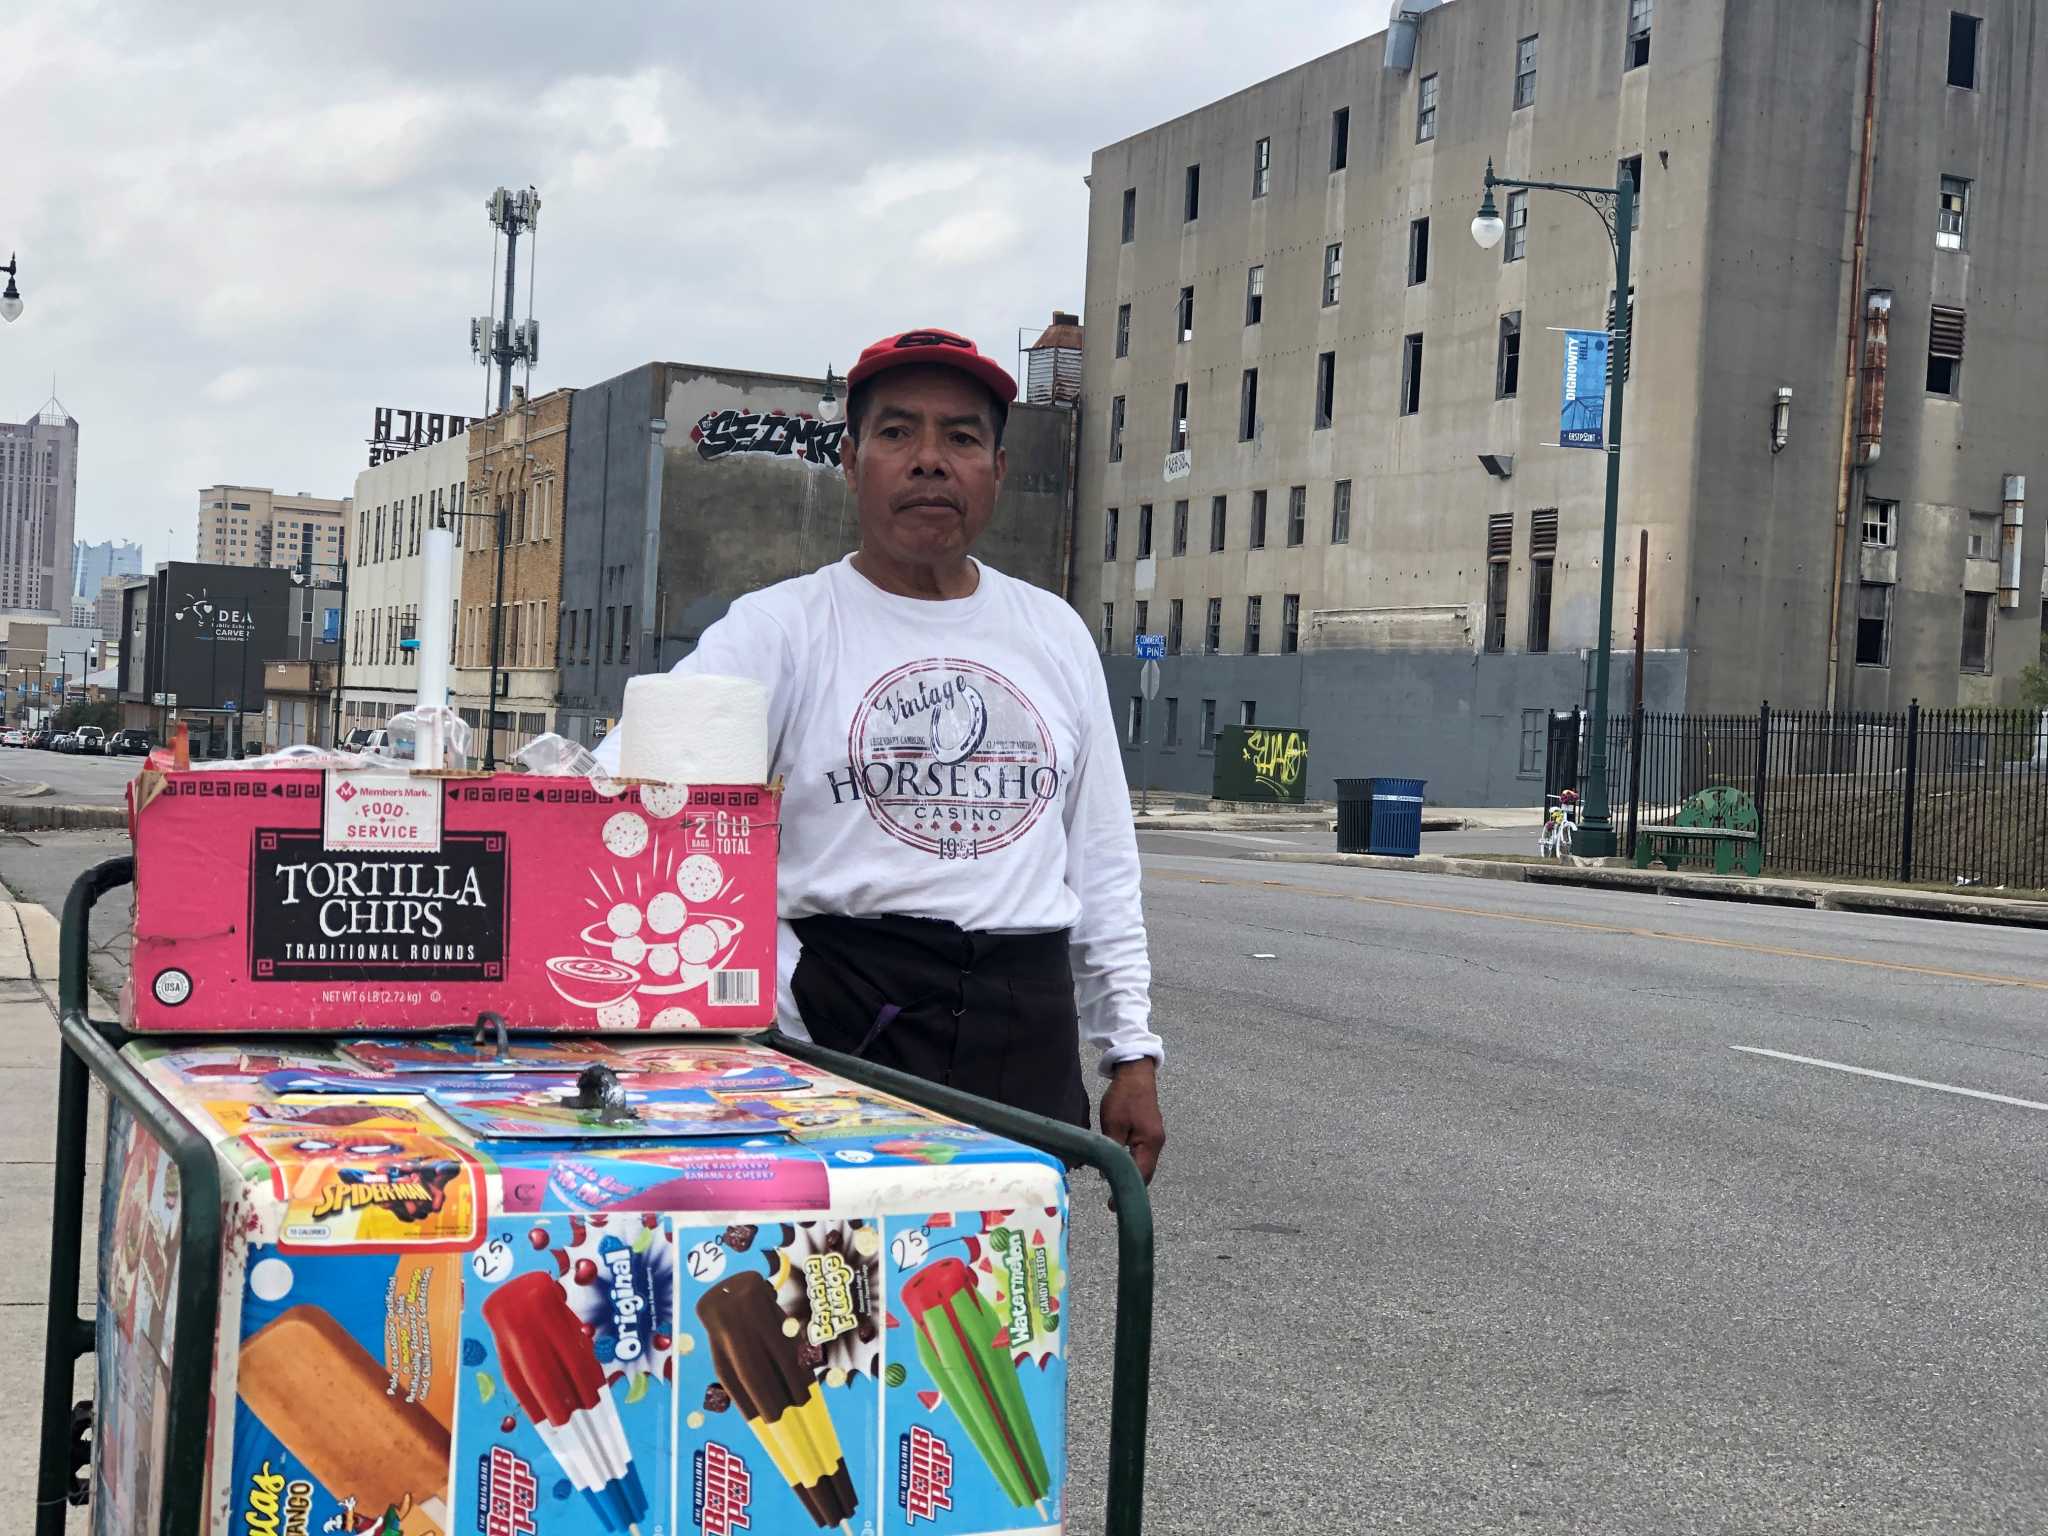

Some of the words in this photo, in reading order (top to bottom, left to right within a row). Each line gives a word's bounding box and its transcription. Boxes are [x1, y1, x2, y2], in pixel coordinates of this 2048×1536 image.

[1579, 338, 1588, 360] HILL
[1566, 337, 1579, 401] DIGNOWITY
[1146, 647, 1165, 657] PINE
[874, 674, 967, 725] Vintage
[360, 788, 403, 798] Member's
[826, 762, 1068, 804] HORSESHO
[361, 802, 404, 818] FOOD
[695, 817, 707, 838] 2
[717, 810, 728, 837] 6
[732, 815, 750, 837] LB
[914, 806, 1002, 821] CASINO
[347, 825, 418, 839] SERVICE
[717, 838, 752, 855] TOTAL
[275, 861, 487, 908] TORTILLA
[319, 899, 443, 938] CHIPS
[285, 943, 400, 961] TRADITIONAL
[410, 944, 476, 961] ROUNDS
[164, 982, 180, 992] USA
[322, 991, 342, 1002] NET
[342, 991, 358, 1002] WT
[359, 991, 366, 1002] 6
[368, 991, 380, 1002] LB
[380, 991, 406, 1004] (2.72
[407, 991, 422, 1005] kg)
[312, 1183, 433, 1219] SPIDER-MAN
[1036, 1248, 1047, 1280] SEEDS
[605, 1249, 644, 1360] Original
[805, 1257, 834, 1344] Banana
[823, 1255, 857, 1334] Fudge
[1004, 1234, 1030, 1345] Watermelon
[1039, 1282, 1050, 1314] CANDY
[703, 1442, 728, 1536] BOMB
[727, 1454, 750, 1529] POP
[907, 1426, 933, 1524] BOMB
[931, 1438, 952, 1510] POP
[285, 1482, 311, 1536] ANGO
[513, 1458, 536, 1534] POP
